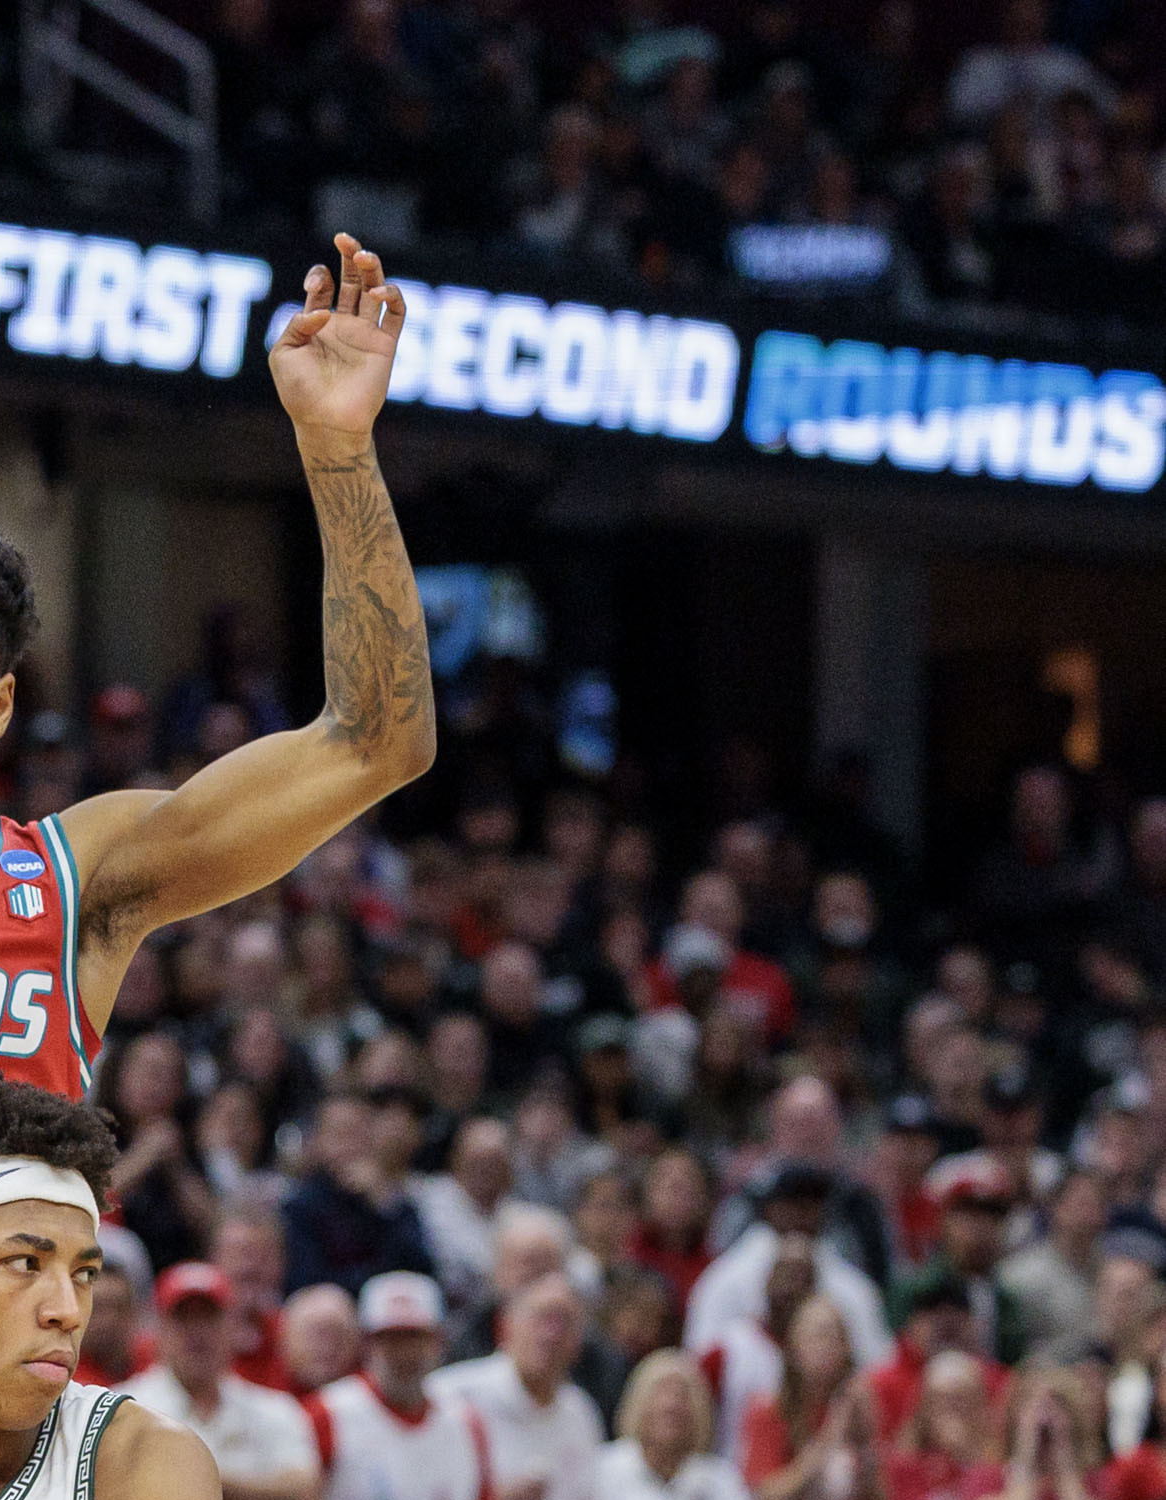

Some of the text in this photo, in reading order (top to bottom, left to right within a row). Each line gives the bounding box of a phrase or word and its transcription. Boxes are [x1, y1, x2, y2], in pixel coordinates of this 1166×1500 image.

[382, 277, 740, 442] SECOND
[746, 330, 1166, 493] ROUNDS
[7, 861, 43, 873] NCAA
